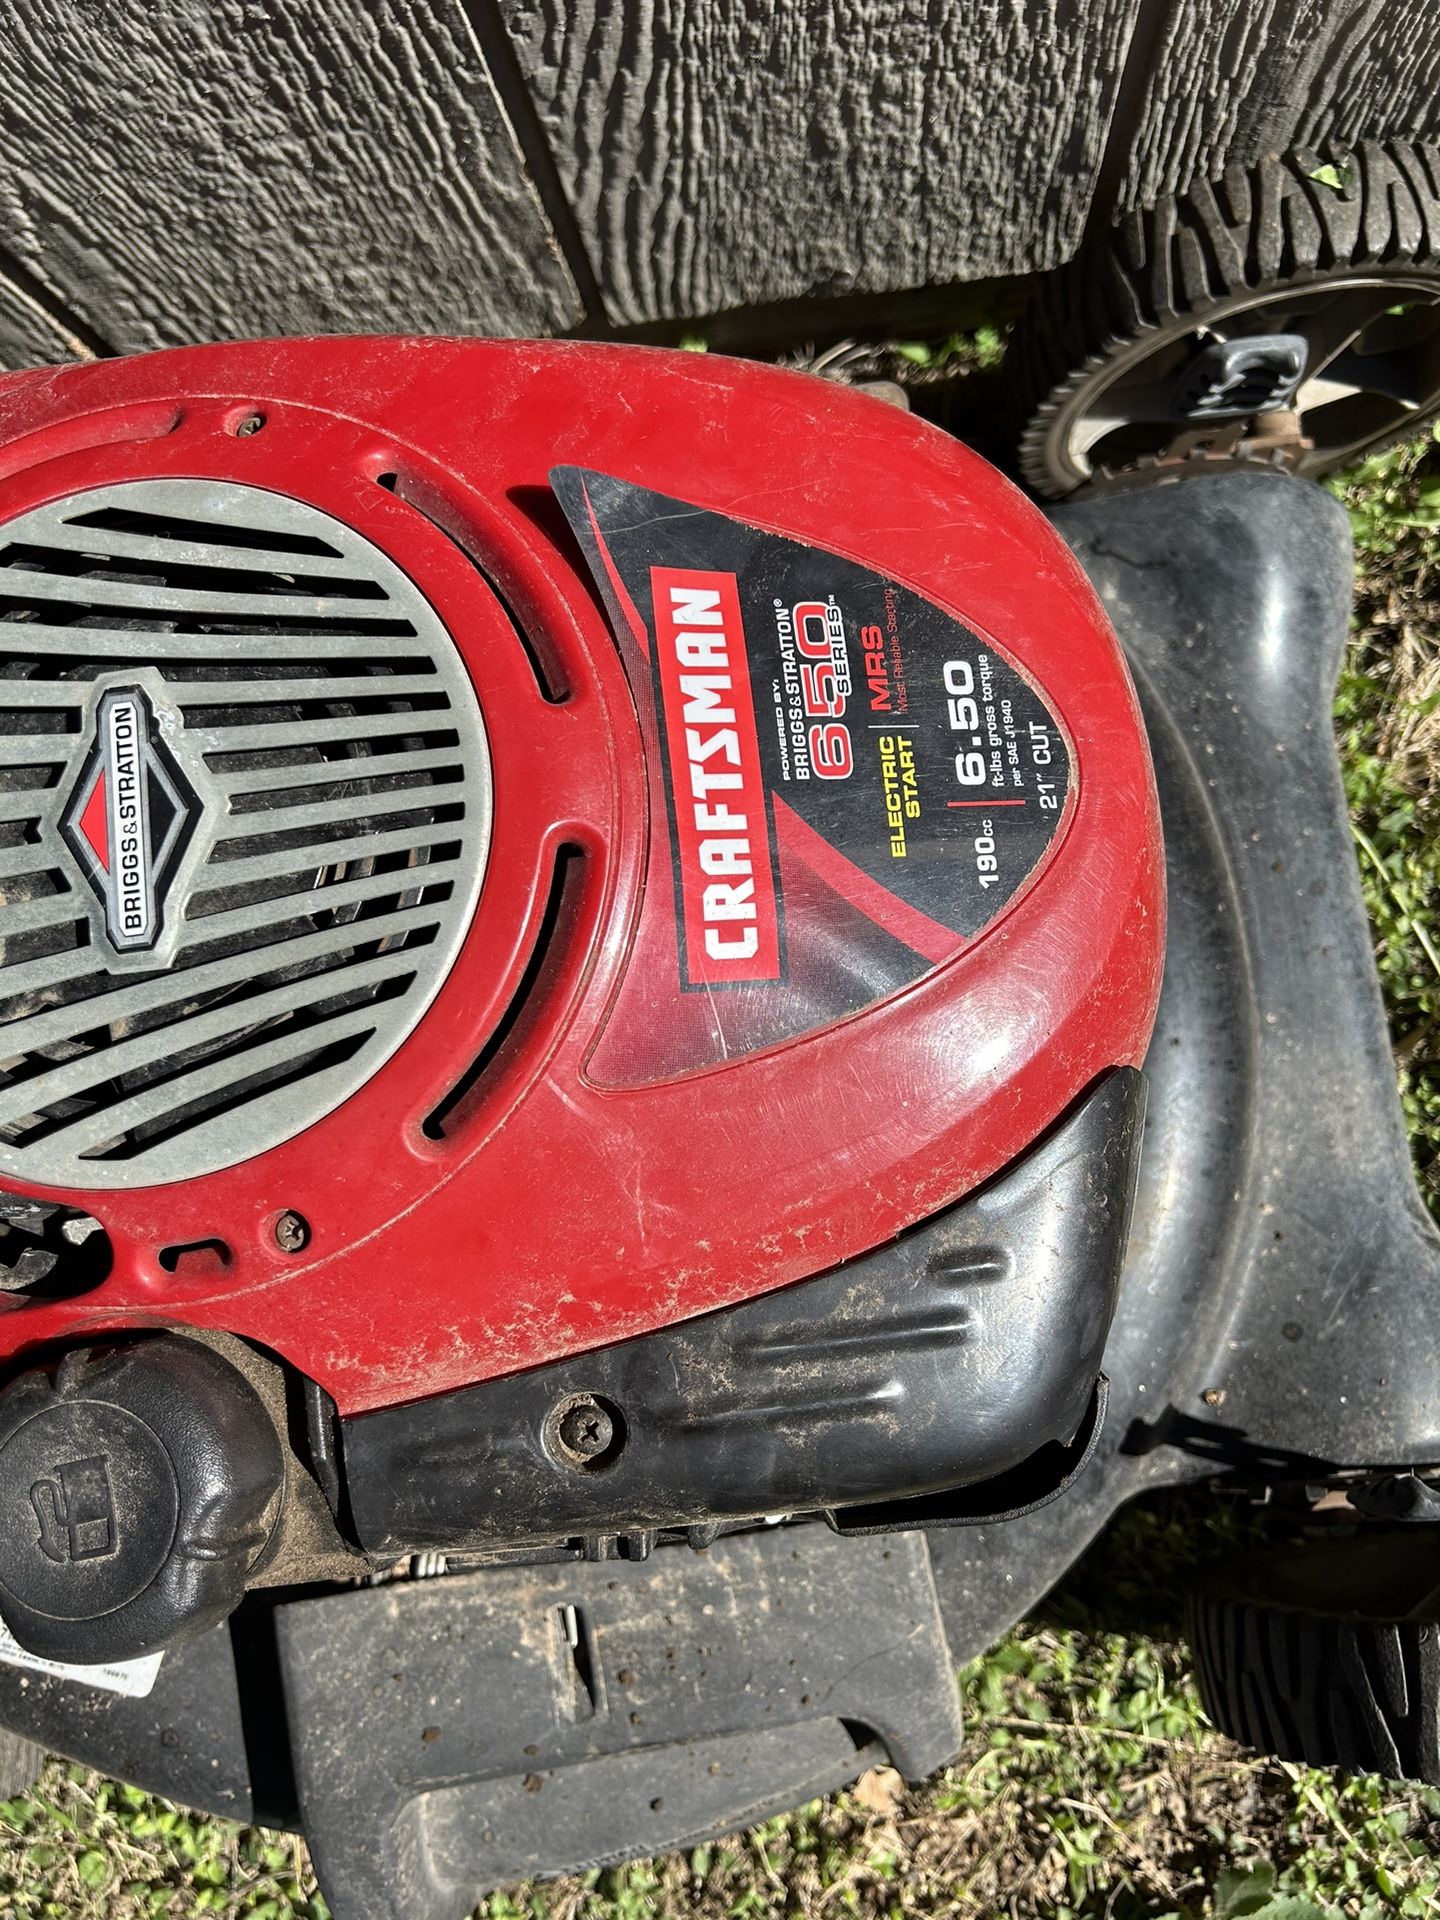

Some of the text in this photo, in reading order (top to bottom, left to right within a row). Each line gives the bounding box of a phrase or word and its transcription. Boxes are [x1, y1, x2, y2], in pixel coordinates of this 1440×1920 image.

[792, 601, 854, 780] 650
[861, 625, 892, 711] MRS
[883, 587, 908, 713] Most Reliable Starting
[669, 586, 759, 961] CRAFTSMAN
[772, 678, 791, 781] POWERED BY:
[896, 736, 921, 818] START
[943, 660, 987, 786] 6.50
[978, 654, 1005, 788] ft-lbs gross torque
[1001, 699, 1024, 787] per SAE J1940
[1029, 720, 1052, 765] CUT
[114, 706, 142, 931] BRIGGS&STRATTON
[879, 736, 907, 858] ELECTRIC
